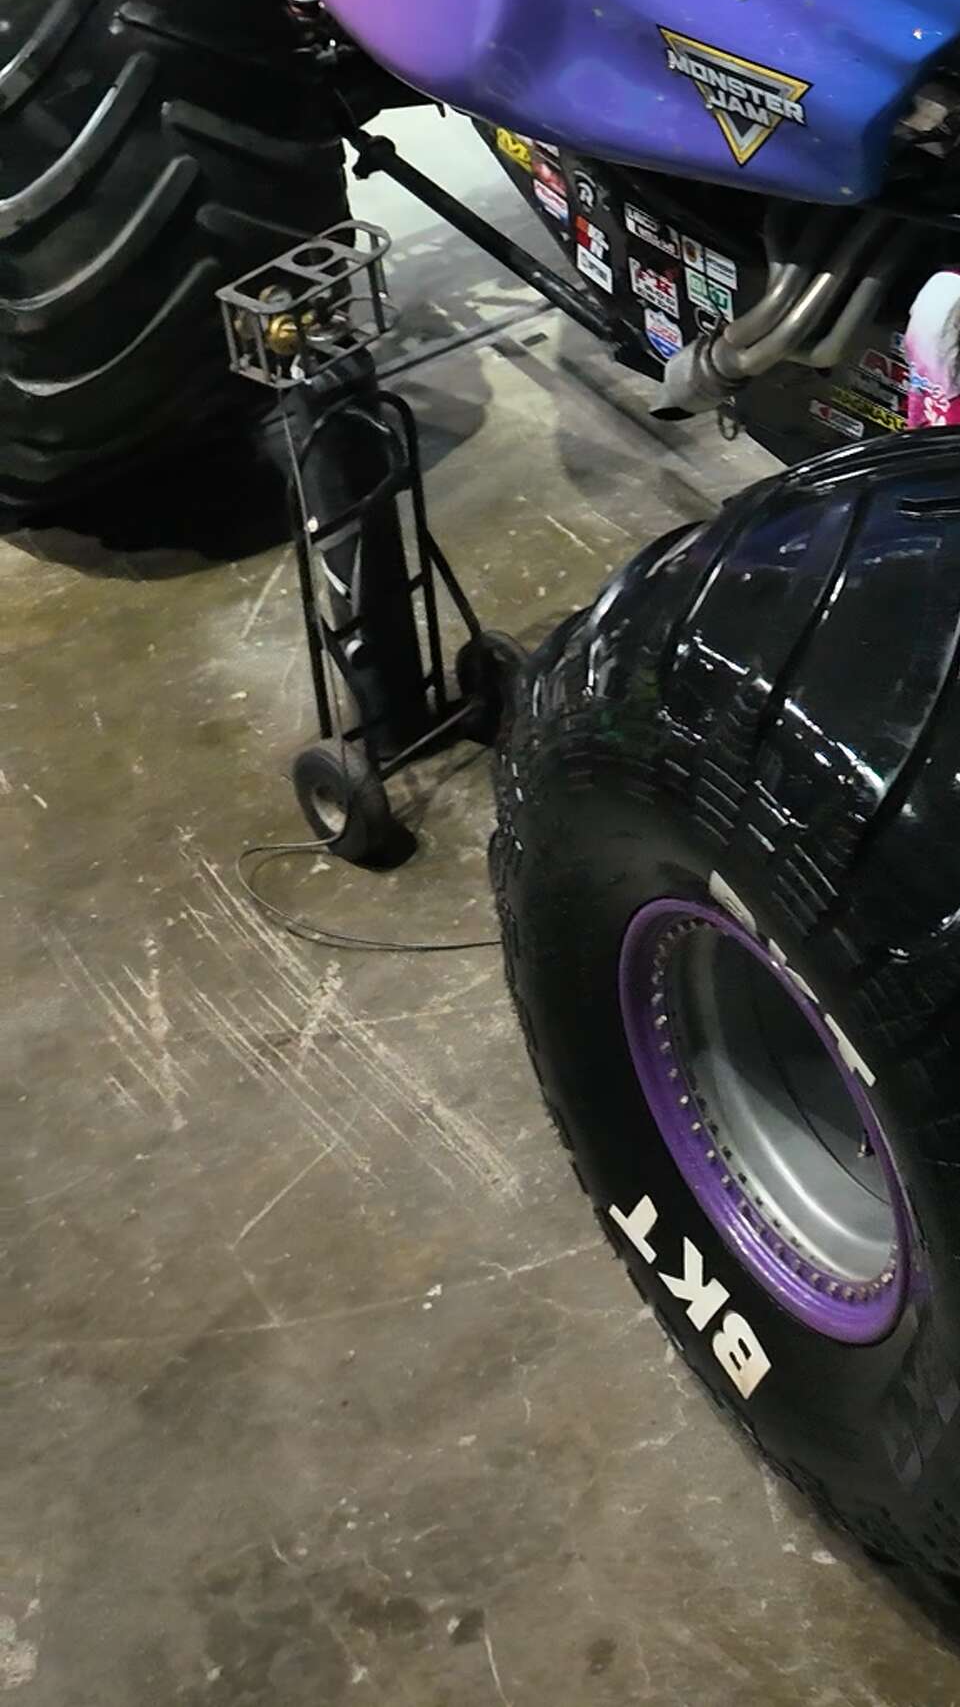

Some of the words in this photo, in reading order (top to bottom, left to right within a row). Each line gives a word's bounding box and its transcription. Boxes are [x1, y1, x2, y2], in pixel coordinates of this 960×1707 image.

[666, 49, 806, 125] MONSTER
[705, 91, 770, 127] JAM
[608, 1194, 772, 1400] BKT
